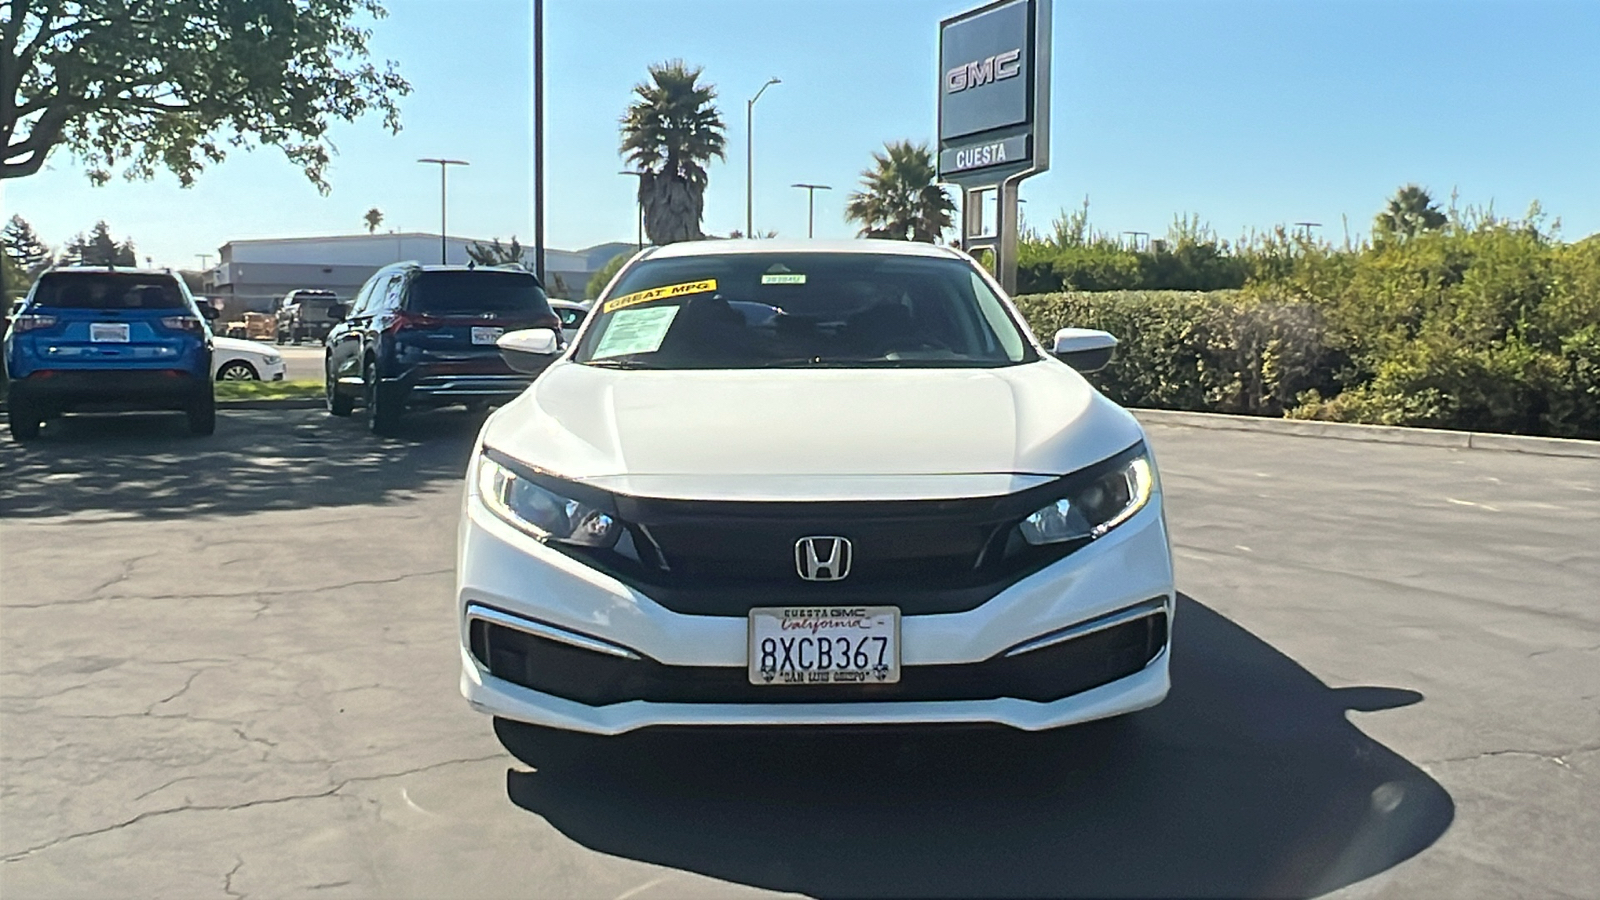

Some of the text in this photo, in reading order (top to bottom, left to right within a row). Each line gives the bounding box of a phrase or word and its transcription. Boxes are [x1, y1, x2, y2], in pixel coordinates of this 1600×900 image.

[946, 48, 1020, 94] GMC
[956, 143, 1006, 169] CUESTA
[609, 283, 709, 309] GREAT MPG
[781, 617, 871, 635] California
[784, 608, 866, 618] CUESTA GMC
[761, 636, 888, 670] 8XCB367
